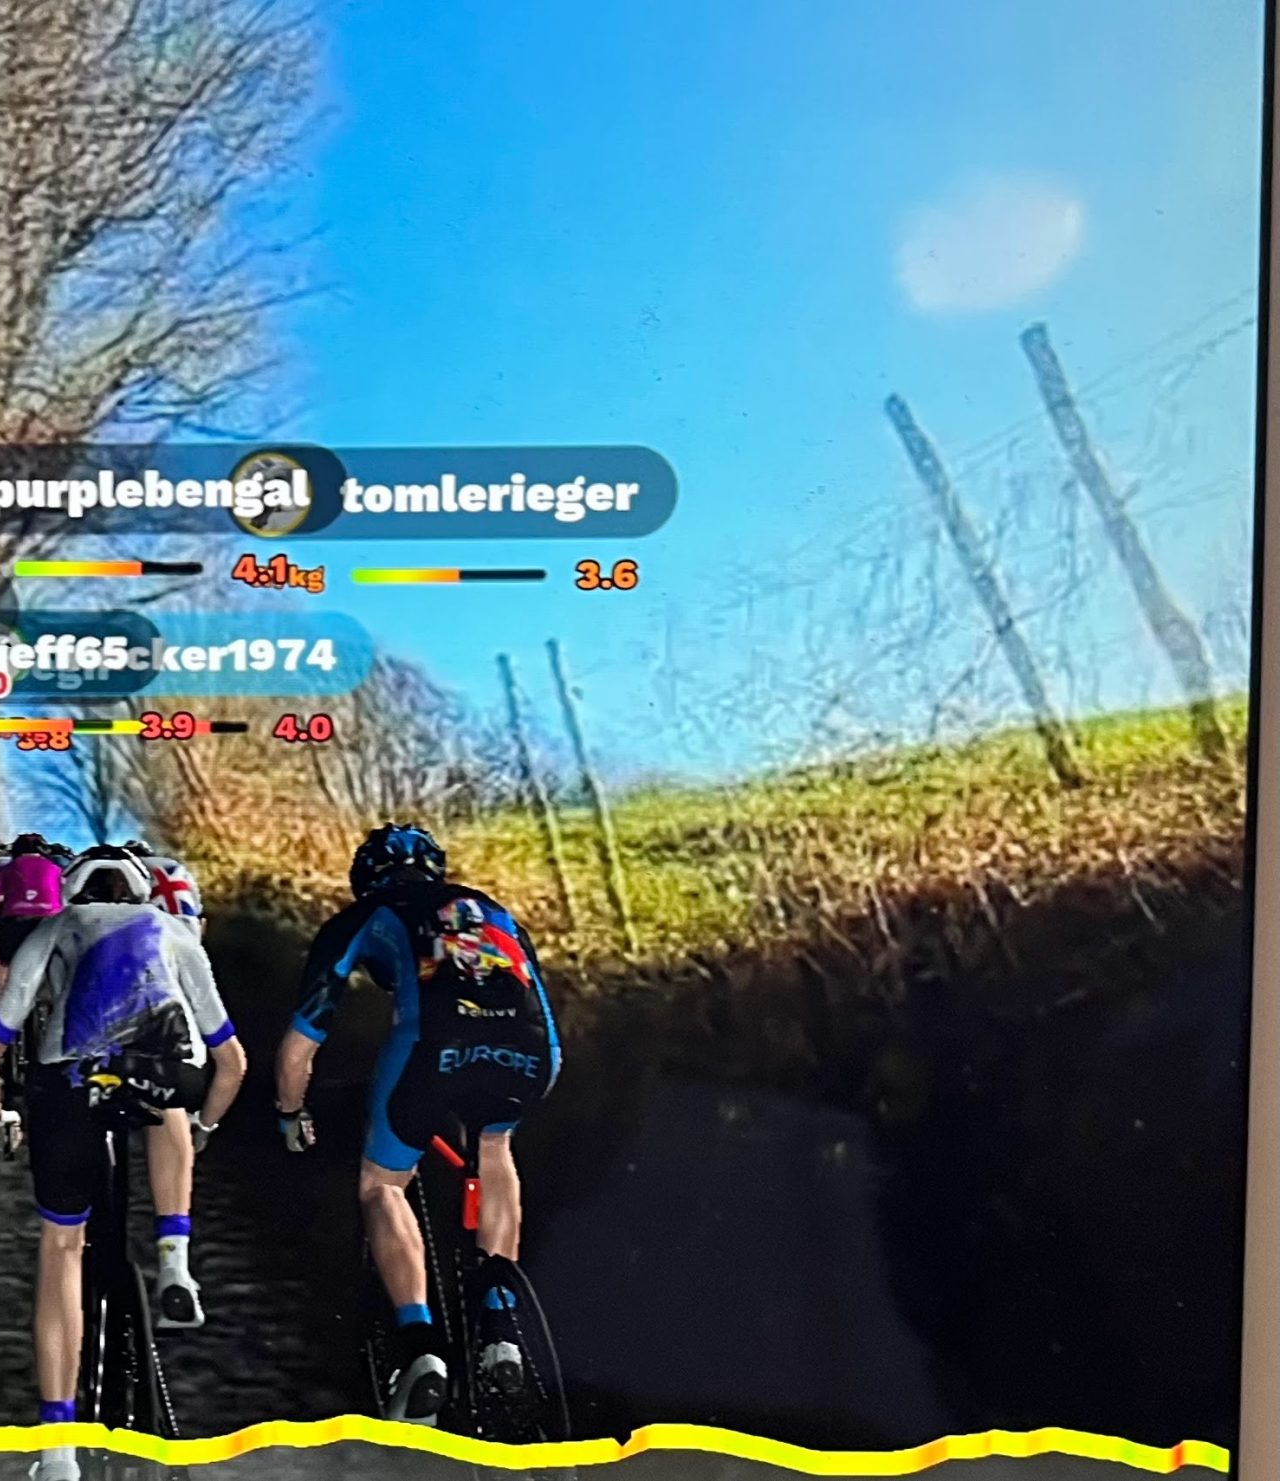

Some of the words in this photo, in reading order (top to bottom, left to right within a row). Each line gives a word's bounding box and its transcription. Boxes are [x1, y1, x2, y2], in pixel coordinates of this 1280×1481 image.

[340, 472, 640, 523] tomlerieger
[231, 553, 289, 583] 4.1
[573, 560, 641, 593] 3.6
[128, 637, 338, 673] cker1974
[139, 711, 197, 741] 3.9
[273, 713, 334, 743] 4.0
[438, 1045, 541, 1079] EUROPE
